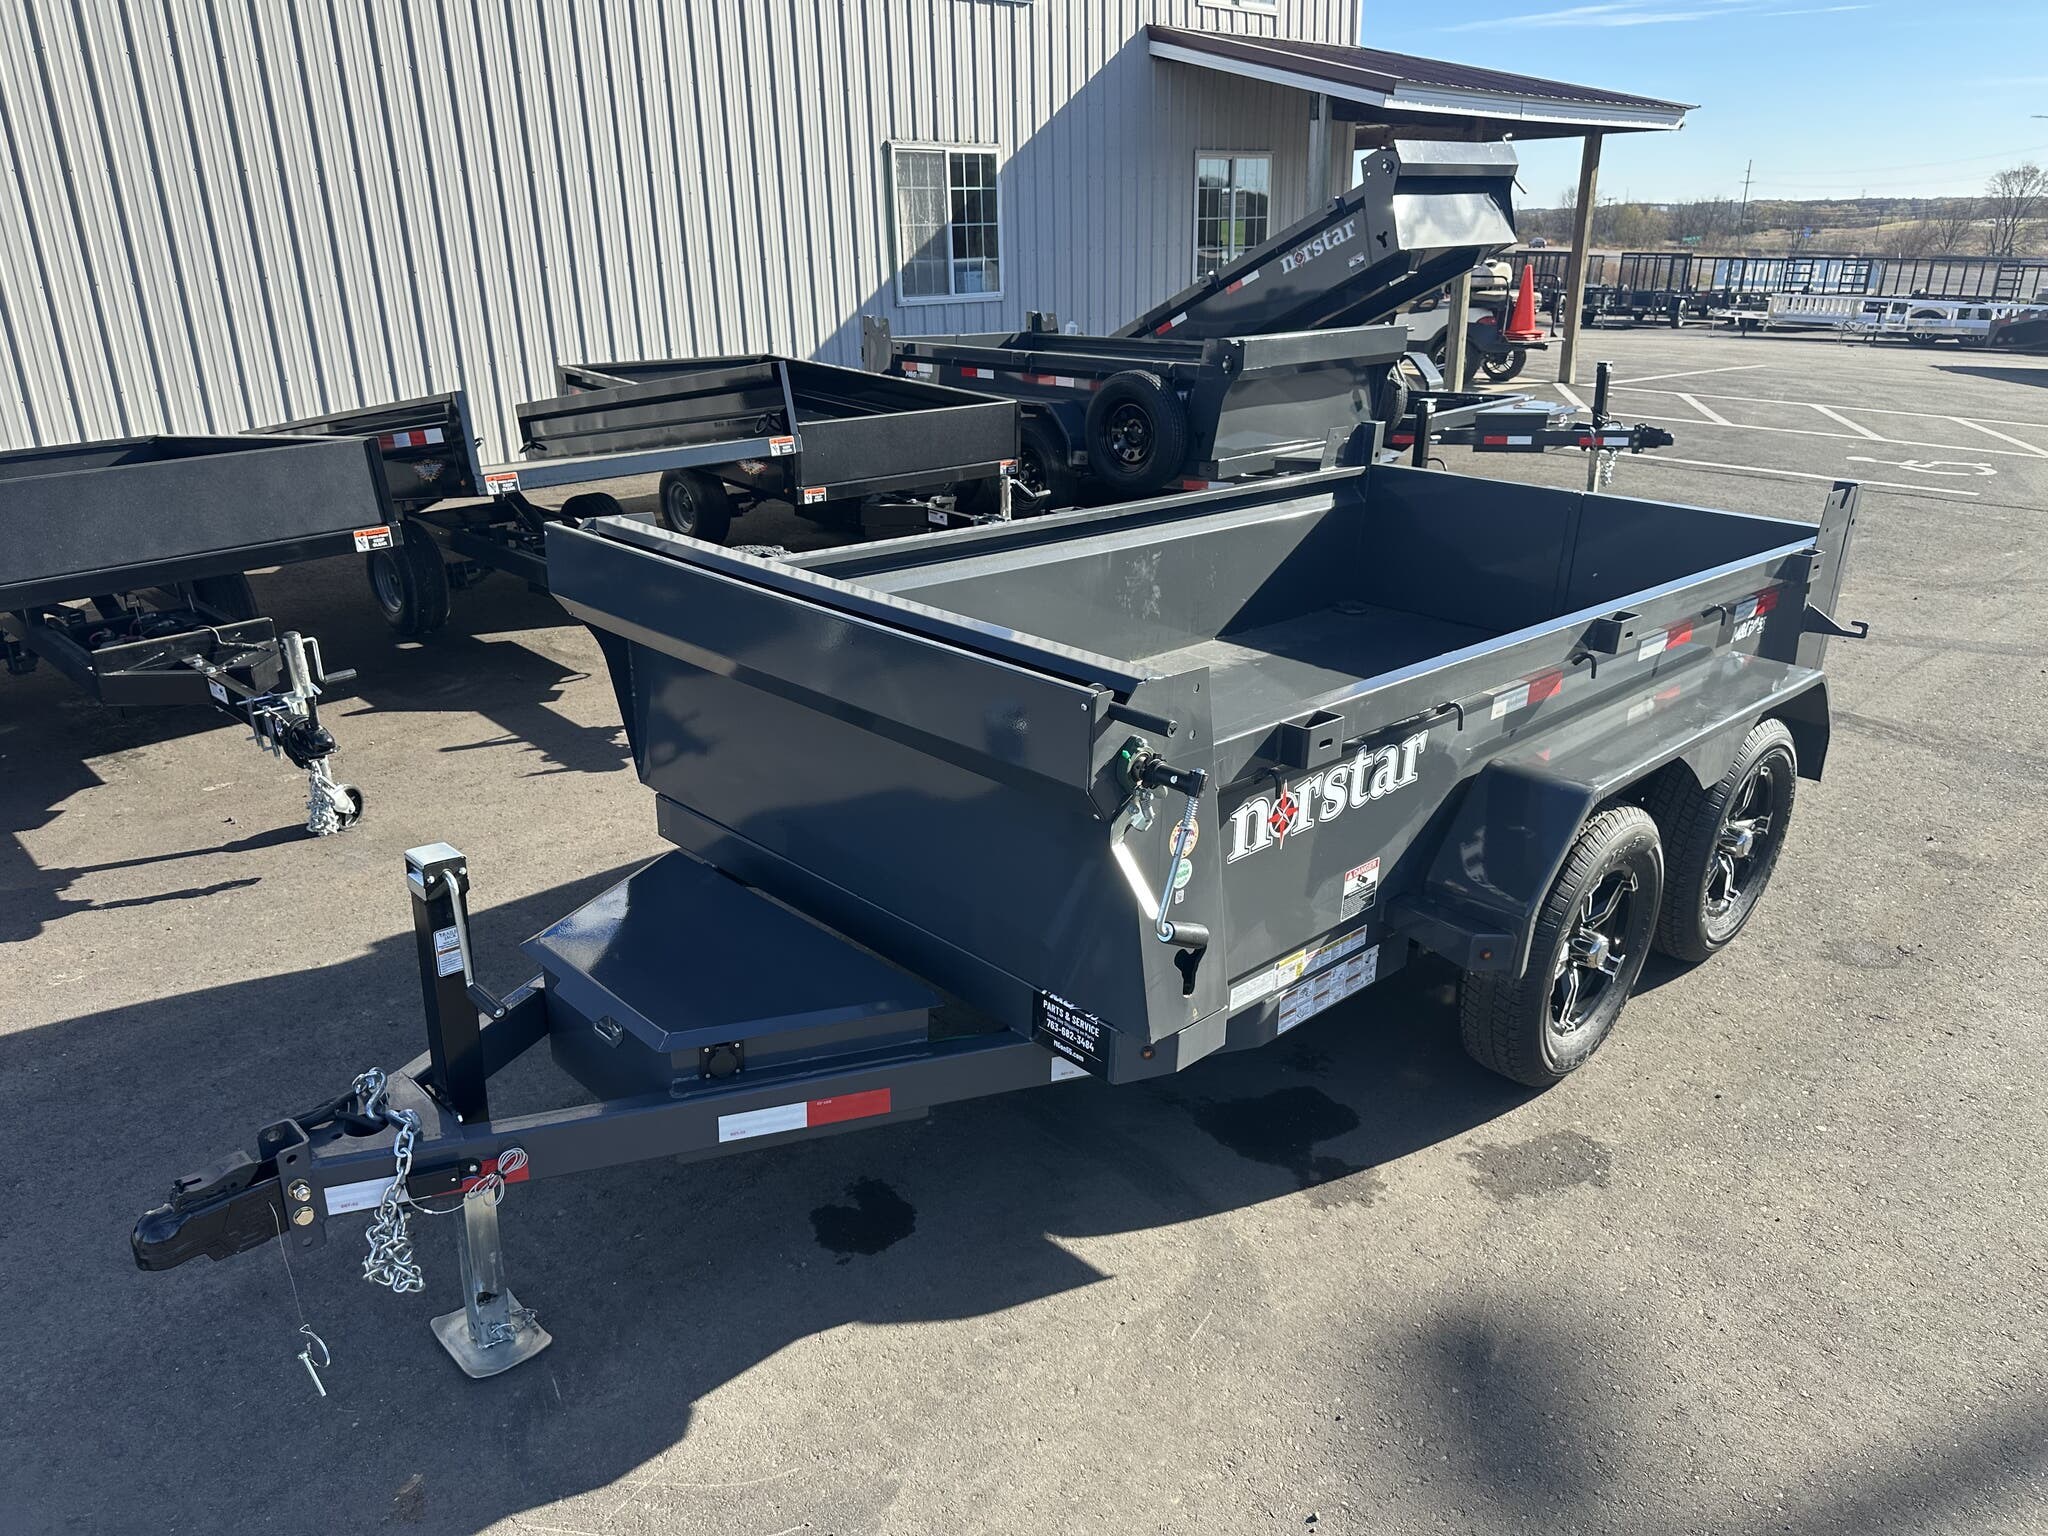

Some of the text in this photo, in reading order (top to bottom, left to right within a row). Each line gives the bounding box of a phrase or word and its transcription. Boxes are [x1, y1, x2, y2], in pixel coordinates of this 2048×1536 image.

[1280, 219, 1356, 274] norstar
[1227, 729, 1430, 864] norstar
[1043, 999, 1064, 1018] PARTS
[1064, 1011, 1071, 1022] &
[1071, 1015, 1100, 1038] SERVICE
[1046, 1017, 1095, 1053] 763-682-3484
